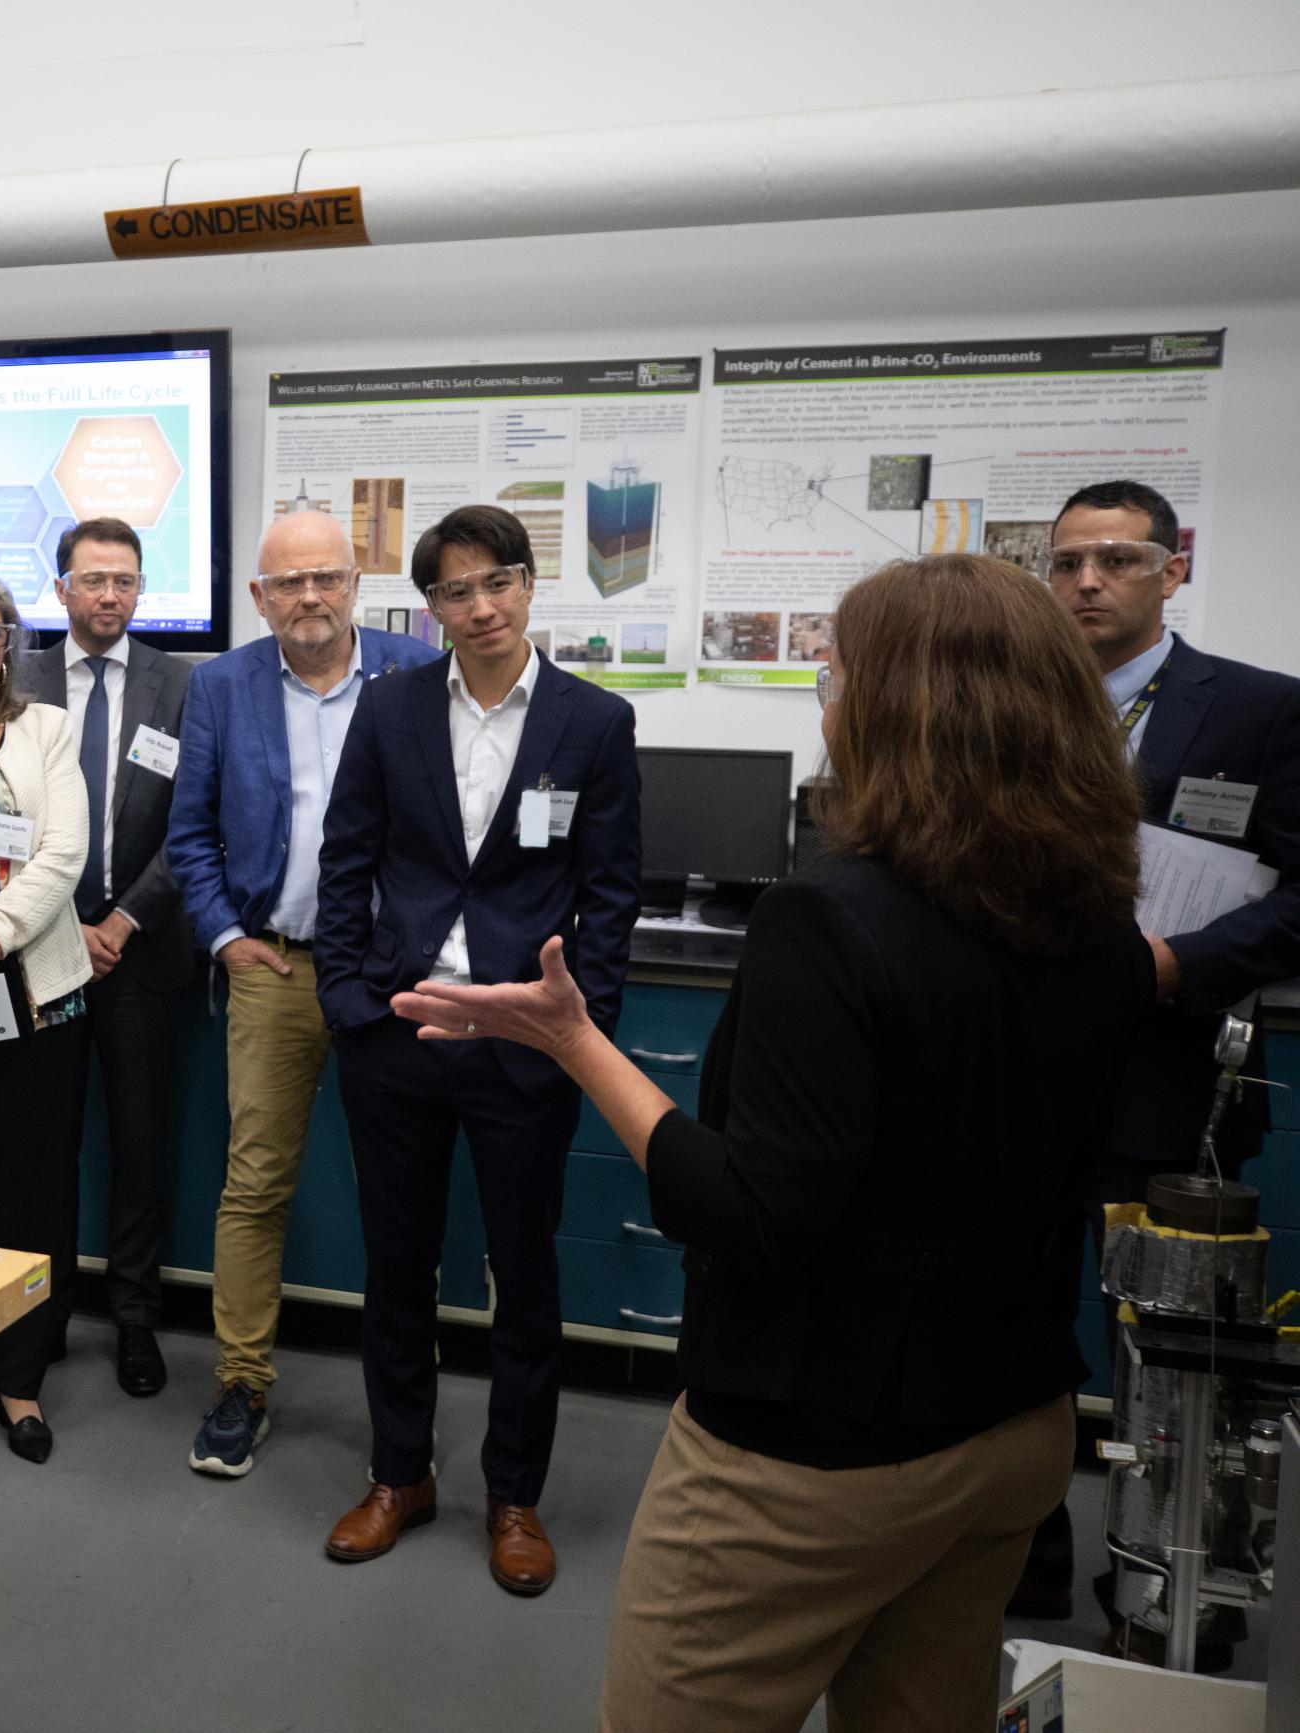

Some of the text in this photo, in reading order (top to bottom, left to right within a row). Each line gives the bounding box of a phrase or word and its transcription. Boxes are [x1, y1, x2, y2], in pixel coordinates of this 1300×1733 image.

[150, 196, 354, 239] CONDENSATE
[724, 360, 782, 374] Integrity
[784, 358, 800, 370] of
[801, 357, 853, 369] Cement
[855, 356, 869, 367] in
[942, 350, 1042, 366] Environments
[13, 389, 42, 403] the
[48, 386, 82, 402] Full
[88, 385, 122, 401] Life
[129, 383, 183, 402] Cycle
[91, 435, 141, 449] Carbon
[1181, 787, 1217, 798] Anthony
